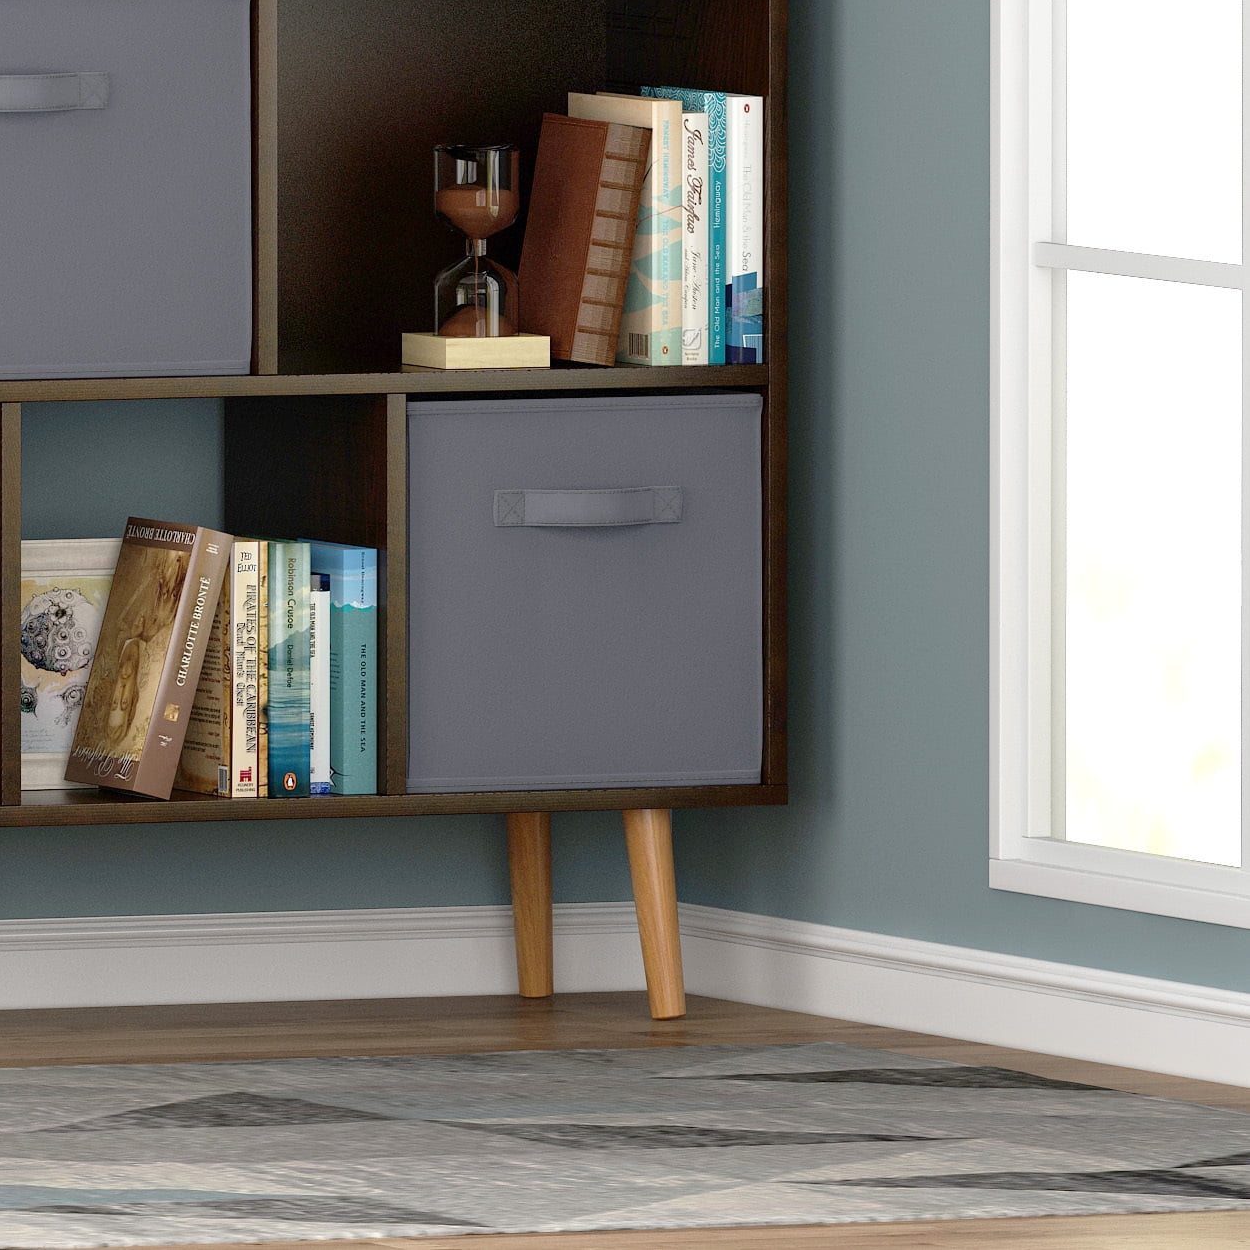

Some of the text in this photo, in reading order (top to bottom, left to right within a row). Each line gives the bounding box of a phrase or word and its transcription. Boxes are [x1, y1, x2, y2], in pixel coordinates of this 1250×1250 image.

[682, 119, 704, 234] James Fairfax
[713, 181, 721, 229] Hemingway
[742, 251, 752, 271] Sea
[153, 529, 196, 545] CHARLOTTE
[288, 557, 296, 629] Robinson Crusoe
[176, 621, 201, 687] CHARLOTTE
[243, 584, 257, 753] PIRATES OF THE CARIBBEAN
[114, 750, 135, 782] The
